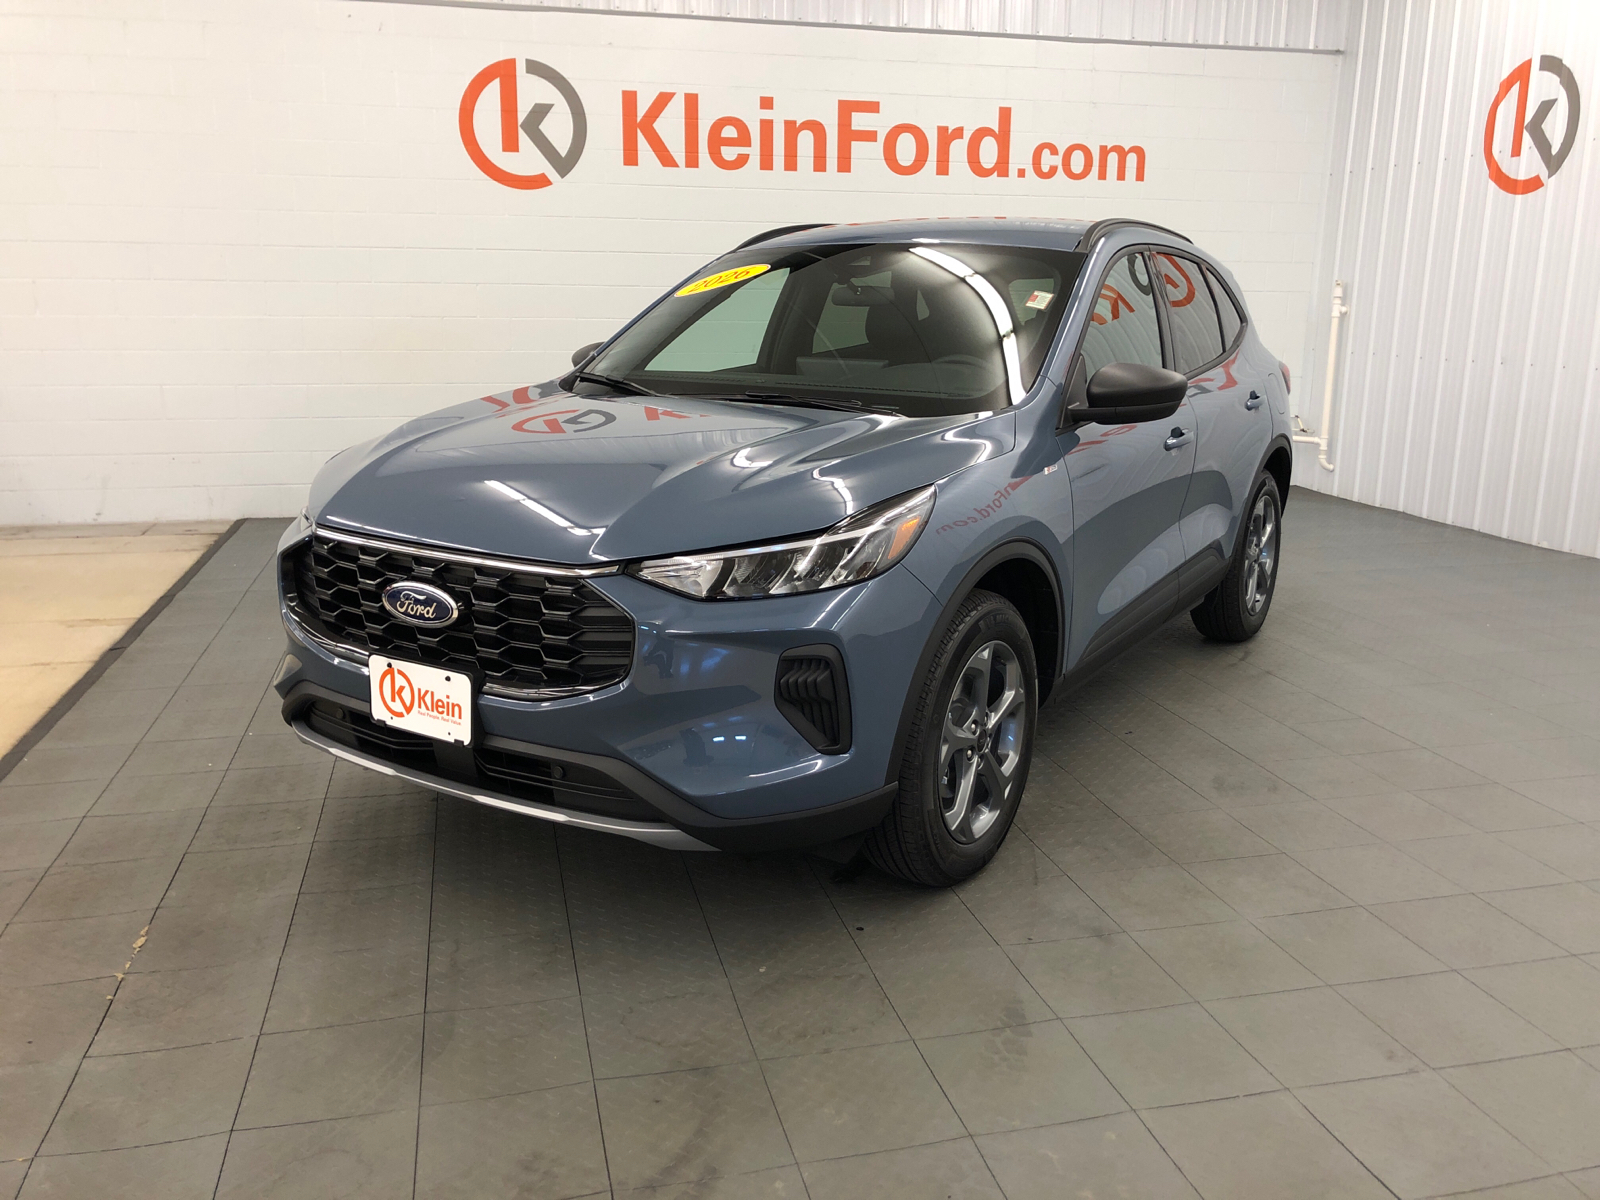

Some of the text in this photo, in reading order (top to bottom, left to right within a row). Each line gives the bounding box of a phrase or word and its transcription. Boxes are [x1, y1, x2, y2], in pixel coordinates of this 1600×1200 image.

[621, 88, 1146, 182] KleinFord.com
[687, 266, 757, 293] 2026
[396, 590, 437, 619] Ford
[417, 687, 462, 720] Klein
